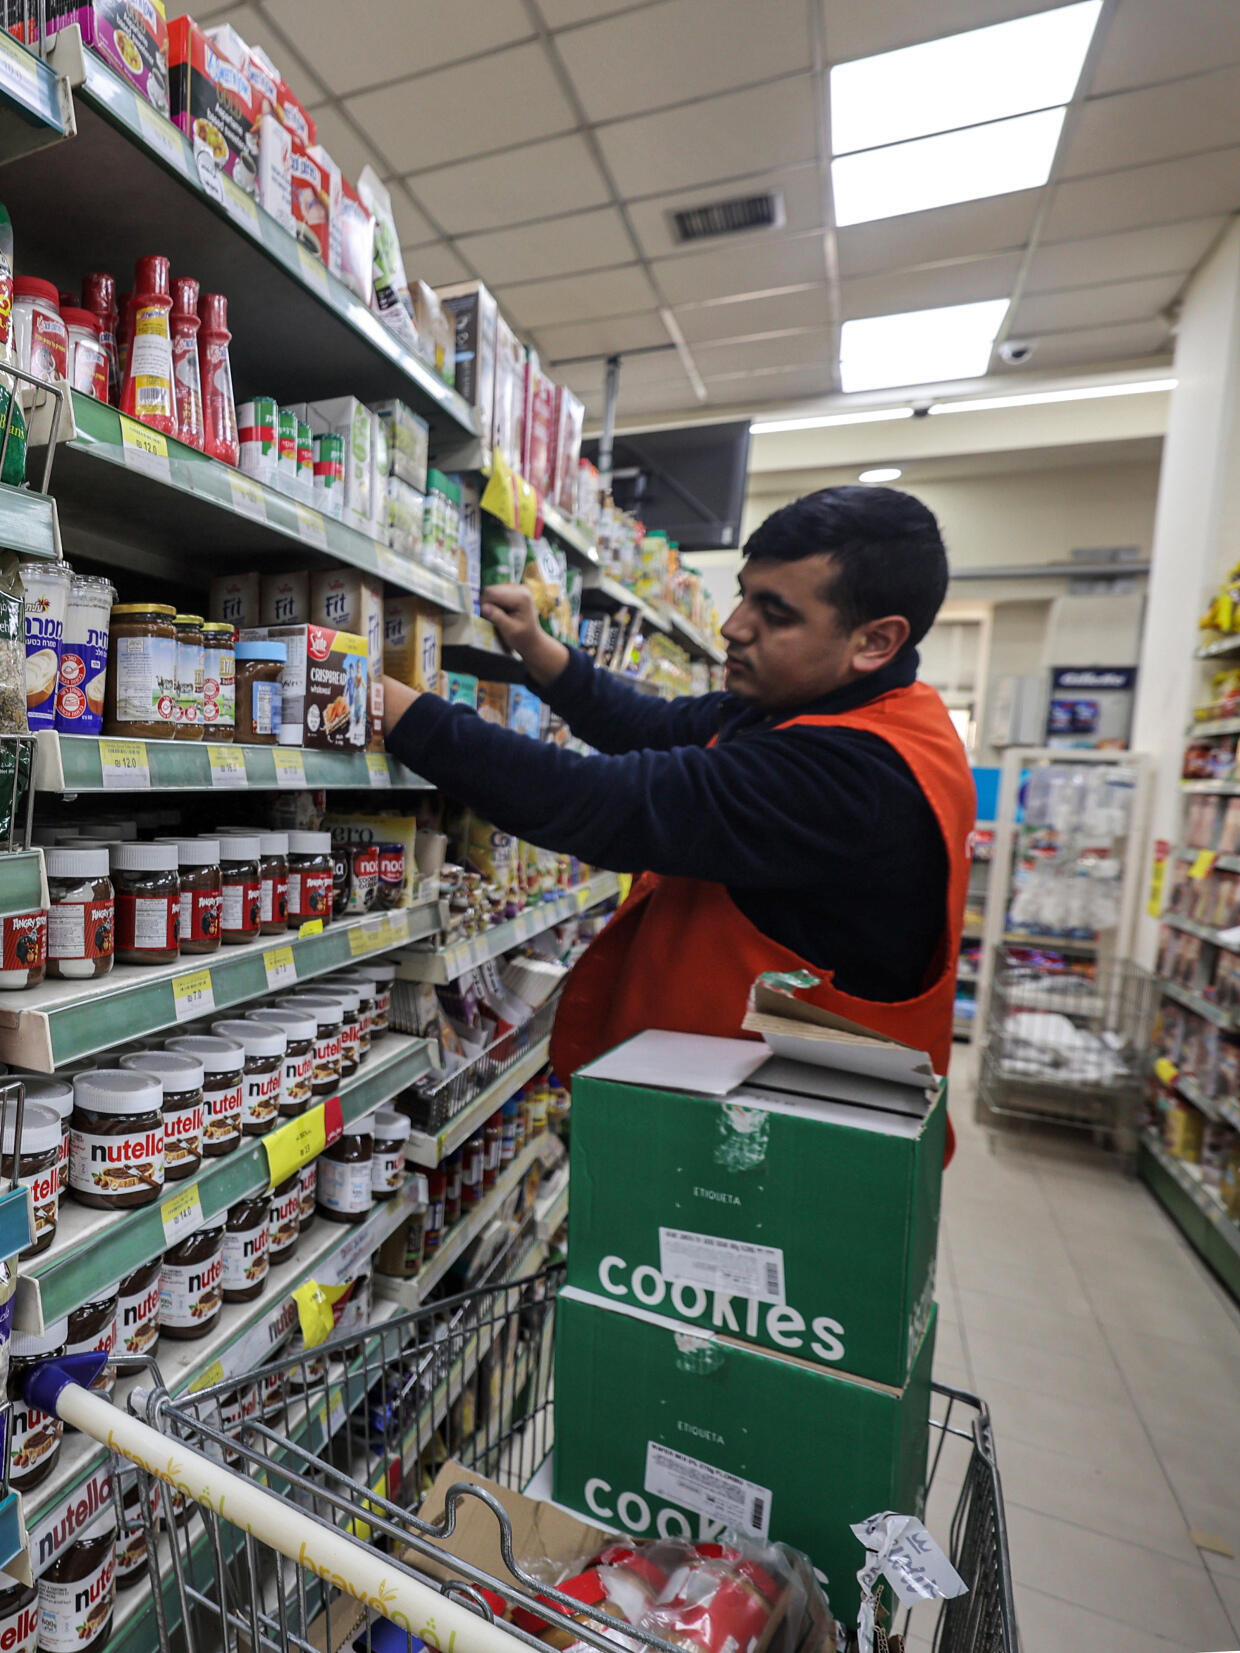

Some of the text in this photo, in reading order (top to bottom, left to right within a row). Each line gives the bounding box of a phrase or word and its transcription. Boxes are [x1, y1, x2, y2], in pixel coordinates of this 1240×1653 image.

[0, 414, 25, 439] Bans
[223, 597, 242, 619] Fit
[275, 597, 294, 619] Fit
[325, 593, 346, 617] Fit
[310, 667, 347, 686] CRISPBREAD
[693, 1185, 741, 1206] ETIQUETA
[598, 1255, 846, 1361] cookies
[677, 1420, 726, 1445] ETIQUETA
[38, 1473, 115, 1566] nutella
